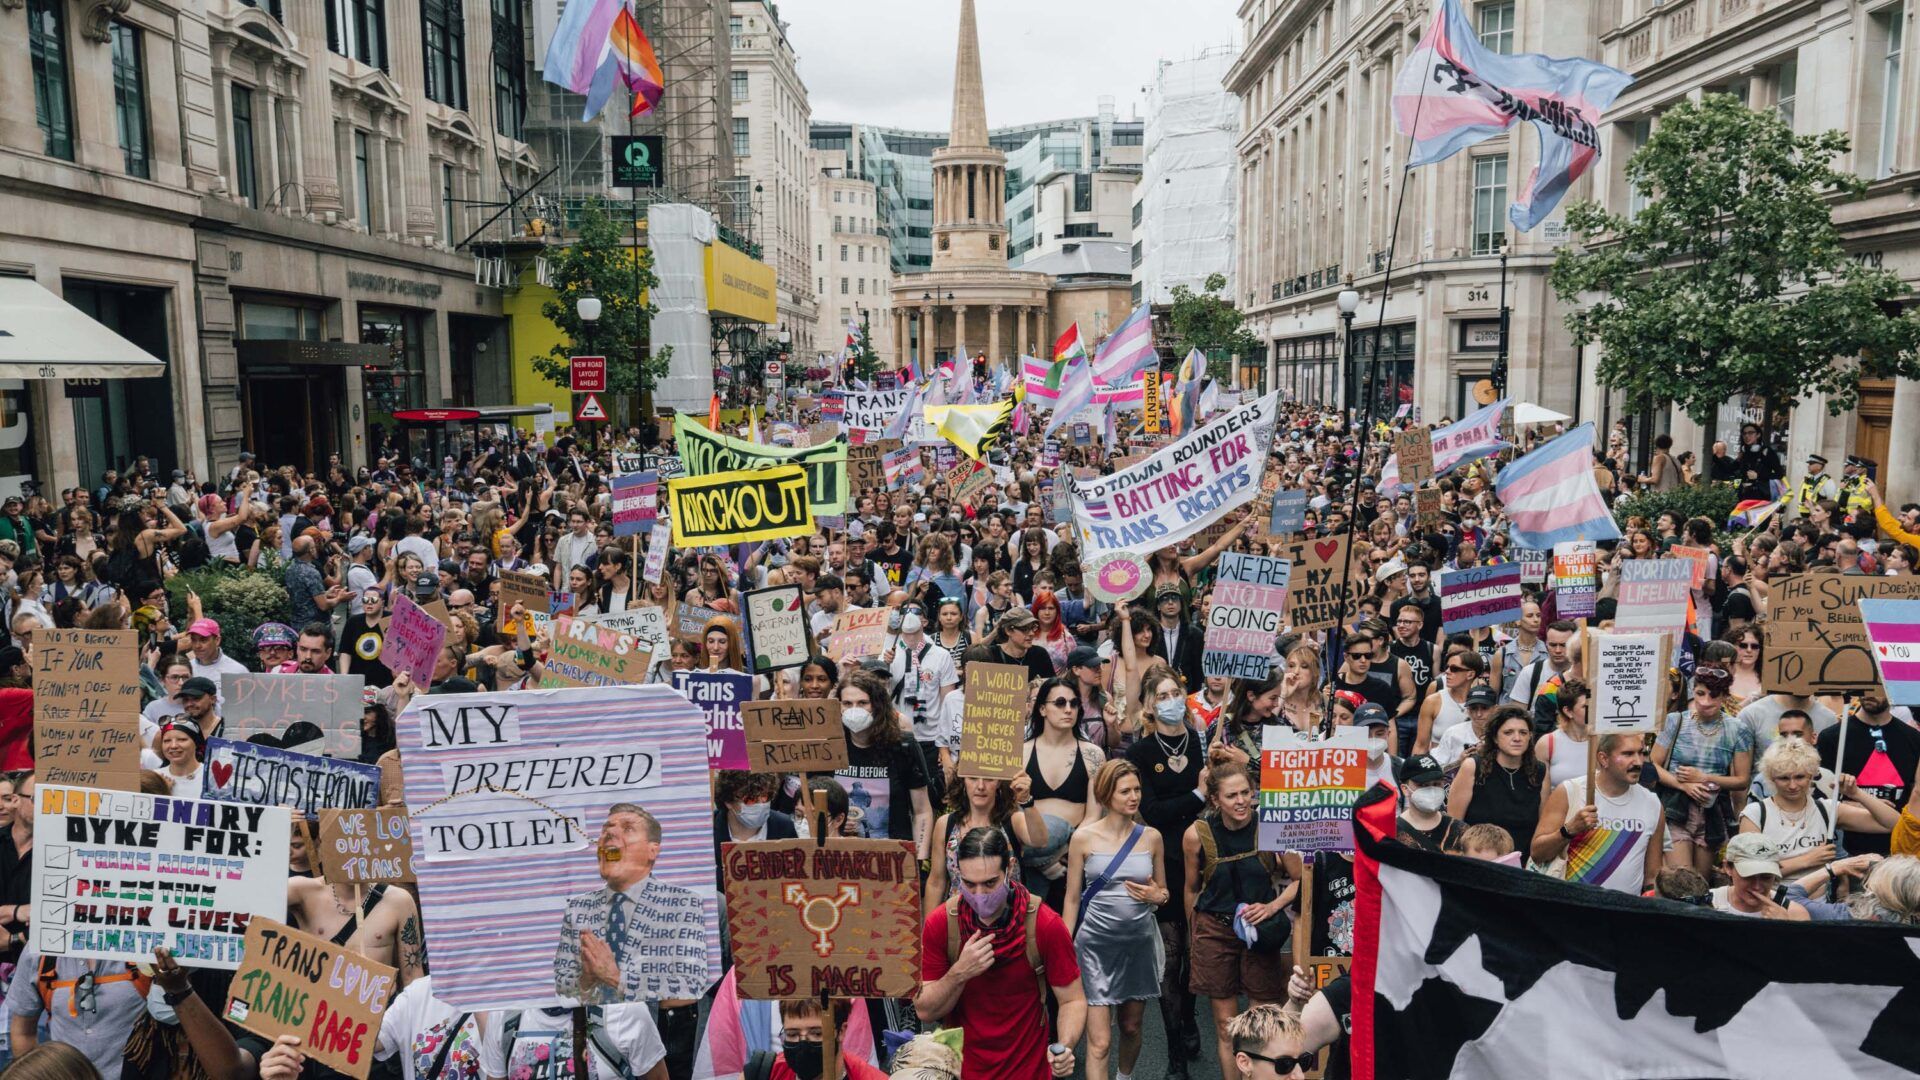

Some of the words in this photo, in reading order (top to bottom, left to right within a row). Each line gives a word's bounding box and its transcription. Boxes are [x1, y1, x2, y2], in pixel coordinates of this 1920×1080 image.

[1468, 290, 1488, 301] 314
[39, 364, 56, 378] atis
[1146, 371, 1158, 428] PARENTS
[1105, 459, 1163, 492] TOWN
[1173, 404, 1262, 465] ROUNDERS
[1114, 462, 1203, 519] BATTING
[1209, 433, 1251, 474] FOR
[680, 481, 806, 533] KNOCKOUT
[1090, 514, 1169, 549] TRANS
[1176, 464, 1251, 523] RIGHTS
[1290, 545, 1307, 568] I
[1558, 554, 1585, 565] FIGHT
[1100, 561, 1139, 579] SAVES
[1220, 553, 1289, 586] WE'RE
[1306, 567, 1333, 587] MY
[1455, 569, 1493, 586] STOP
[1623, 560, 1667, 581] SPORT
[1668, 559, 1679, 579] IS
[1680, 560, 1690, 578] A
[1221, 586, 1276, 608] NOT
[1293, 580, 1354, 604] TRANS
[1450, 584, 1508, 603] POLICING
[1626, 582, 1688, 602] LIFELINE
[1772, 574, 1813, 601] THE
[1819, 577, 1875, 610] SUN
[605, 617, 635, 629] TRYING
[642, 613, 657, 623] TO
[1211, 606, 1279, 632] GOING
[1449, 609, 1473, 622] OUR
[1773, 607, 1786, 620] IF
[409, 611, 436, 640] TRANS
[558, 614, 634, 656] TRANS
[624, 625, 649, 636] THE
[45, 631, 62, 643] NO
[67, 632, 79, 644] TO
[759, 631, 800, 649] DOWN
[1205, 630, 1274, 654] FUCKING
[1790, 632, 1801, 641] IT
[1832, 633, 1867, 644] SIMPLY
[40, 648, 64, 672] IF
[68, 648, 104, 671] YOUR
[404, 647, 424, 667] NOW
[553, 640, 628, 673] WOMEN'S
[770, 642, 803, 659] PRIDE
[1889, 643, 1910, 658] YOU
[1203, 652, 1271, 680] ANYWHERE
[1768, 650, 1803, 685] TO
[36, 679, 80, 698] FEMINISM
[84, 681, 112, 693] DOES
[118, 684, 138, 695] NOT
[233, 677, 340, 704] DYKES
[675, 673, 735, 702] Trans
[971, 671, 980, 687] A
[986, 672, 1024, 691] WORLD
[77, 698, 109, 719] ALL
[976, 691, 1015, 705] WITHOUT
[748, 706, 826, 729] TRANS
[966, 703, 992, 719] TRANS
[993, 707, 1022, 722] PEOPLE
[40, 726, 75, 740] WOMEN
[101, 728, 136, 743] THEN
[423, 704, 514, 747] MY
[963, 722, 983, 735] HAS
[987, 723, 1015, 736] NEVER
[39, 743, 63, 759] IT
[67, 744, 81, 756] IS
[88, 747, 116, 759] NOT
[976, 735, 1013, 752] EXISTED
[960, 751, 978, 762] AND
[979, 753, 1003, 766] NEVER
[1005, 755, 1023, 769] WILL
[1269, 750, 1320, 769] FIGHT
[1322, 749, 1358, 767] FOR
[46, 766, 98, 784] FEMINISM
[451, 752, 654, 796] PREFERED
[860, 765, 888, 778] BEFORE
[1282, 768, 1345, 788] TRANS
[231, 752, 375, 816] TESTOSTERONE
[1264, 789, 1359, 808] LIBERATION
[339, 813, 367, 836] WE
[1263, 809, 1291, 822] AND
[1294, 822, 1315, 830] INJURY
[66, 816, 161, 848] DYKE
[184, 826, 262, 858] FOR:
[430, 816, 579, 853] TOILET
[77, 849, 151, 871] TRANS
[157, 853, 245, 880] RIGHTS
[342, 857, 403, 880] TRANS
[730, 849, 808, 881] GENDER
[812, 850, 907, 883] ANARCHY
[76, 878, 217, 908] PALESTINE
[73, 904, 154, 927] BLACK
[168, 907, 250, 935] LIVES
[72, 929, 166, 955] CLIMATE
[261, 930, 330, 983] TRANS
[329, 954, 390, 1014] LOVE
[766, 965, 797, 996] IS
[811, 965, 885, 996] MAGIC
[242, 968, 309, 1026] TRANS
[308, 1000, 368, 1065] RAGE
